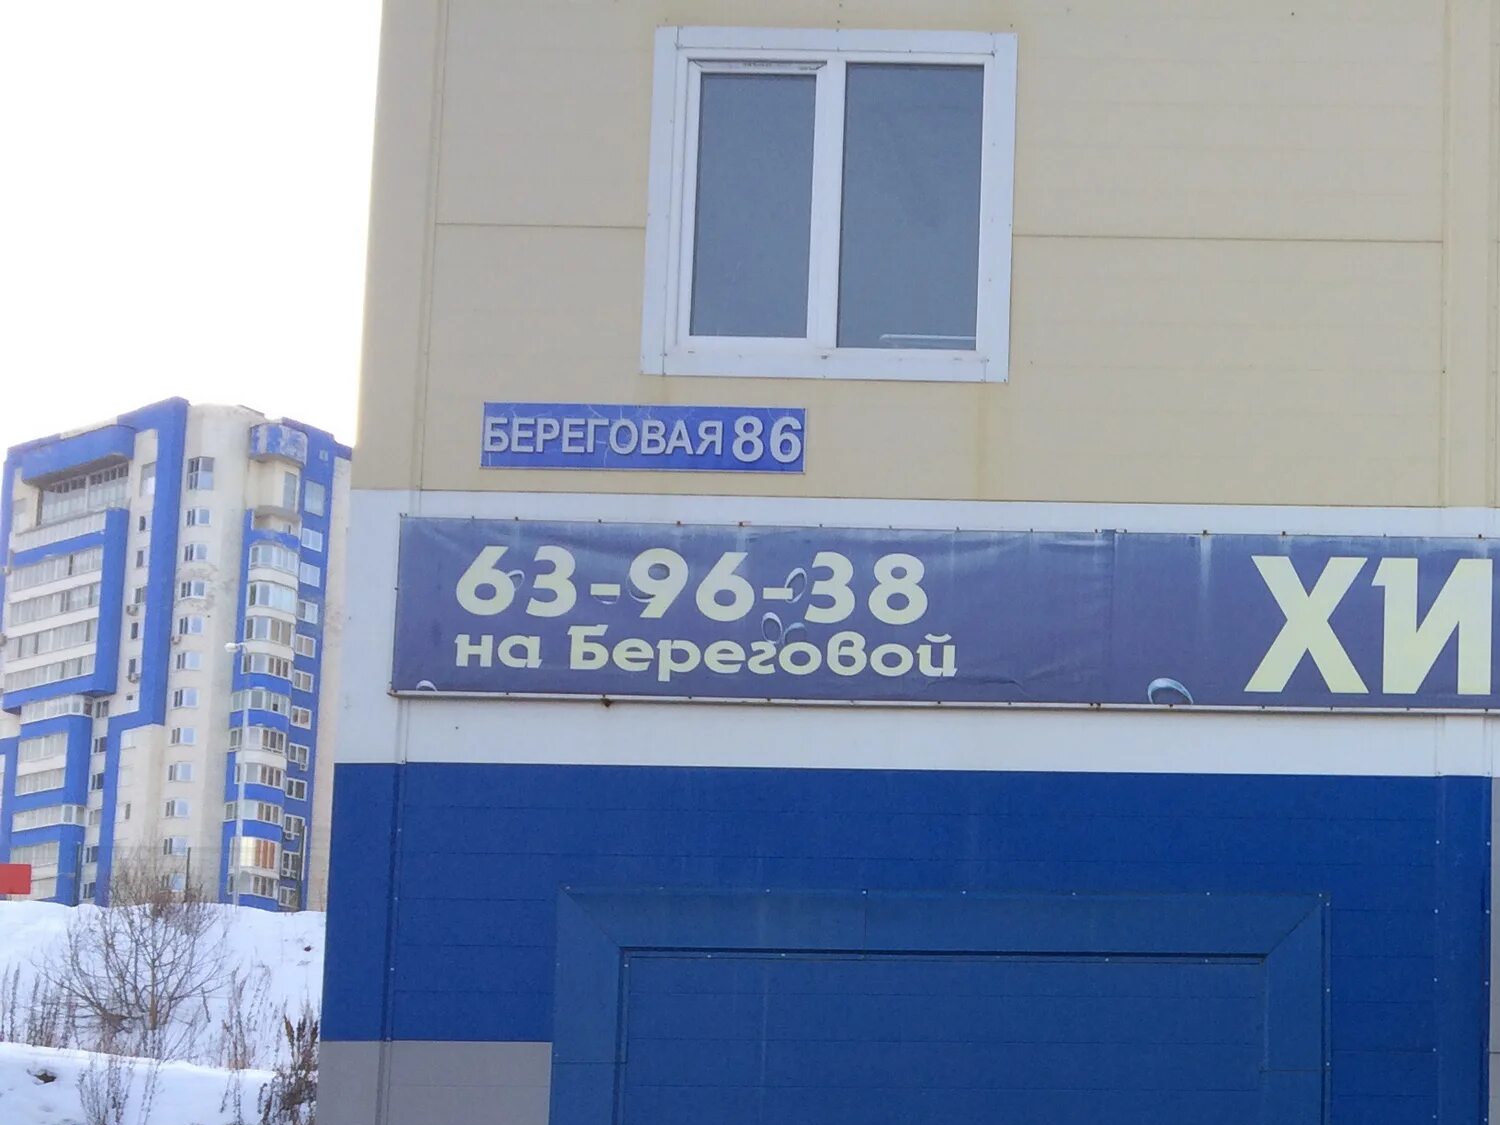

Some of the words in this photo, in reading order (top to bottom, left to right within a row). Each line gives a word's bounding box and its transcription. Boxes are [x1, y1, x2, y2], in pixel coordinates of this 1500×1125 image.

[483, 416, 724, 456] БЕРЕГОВАЯ
[731, 416, 803, 463] 86
[455, 545, 928, 626] 63-96-38
[454, 633, 543, 670] на
[568, 624, 958, 682] Береговой
